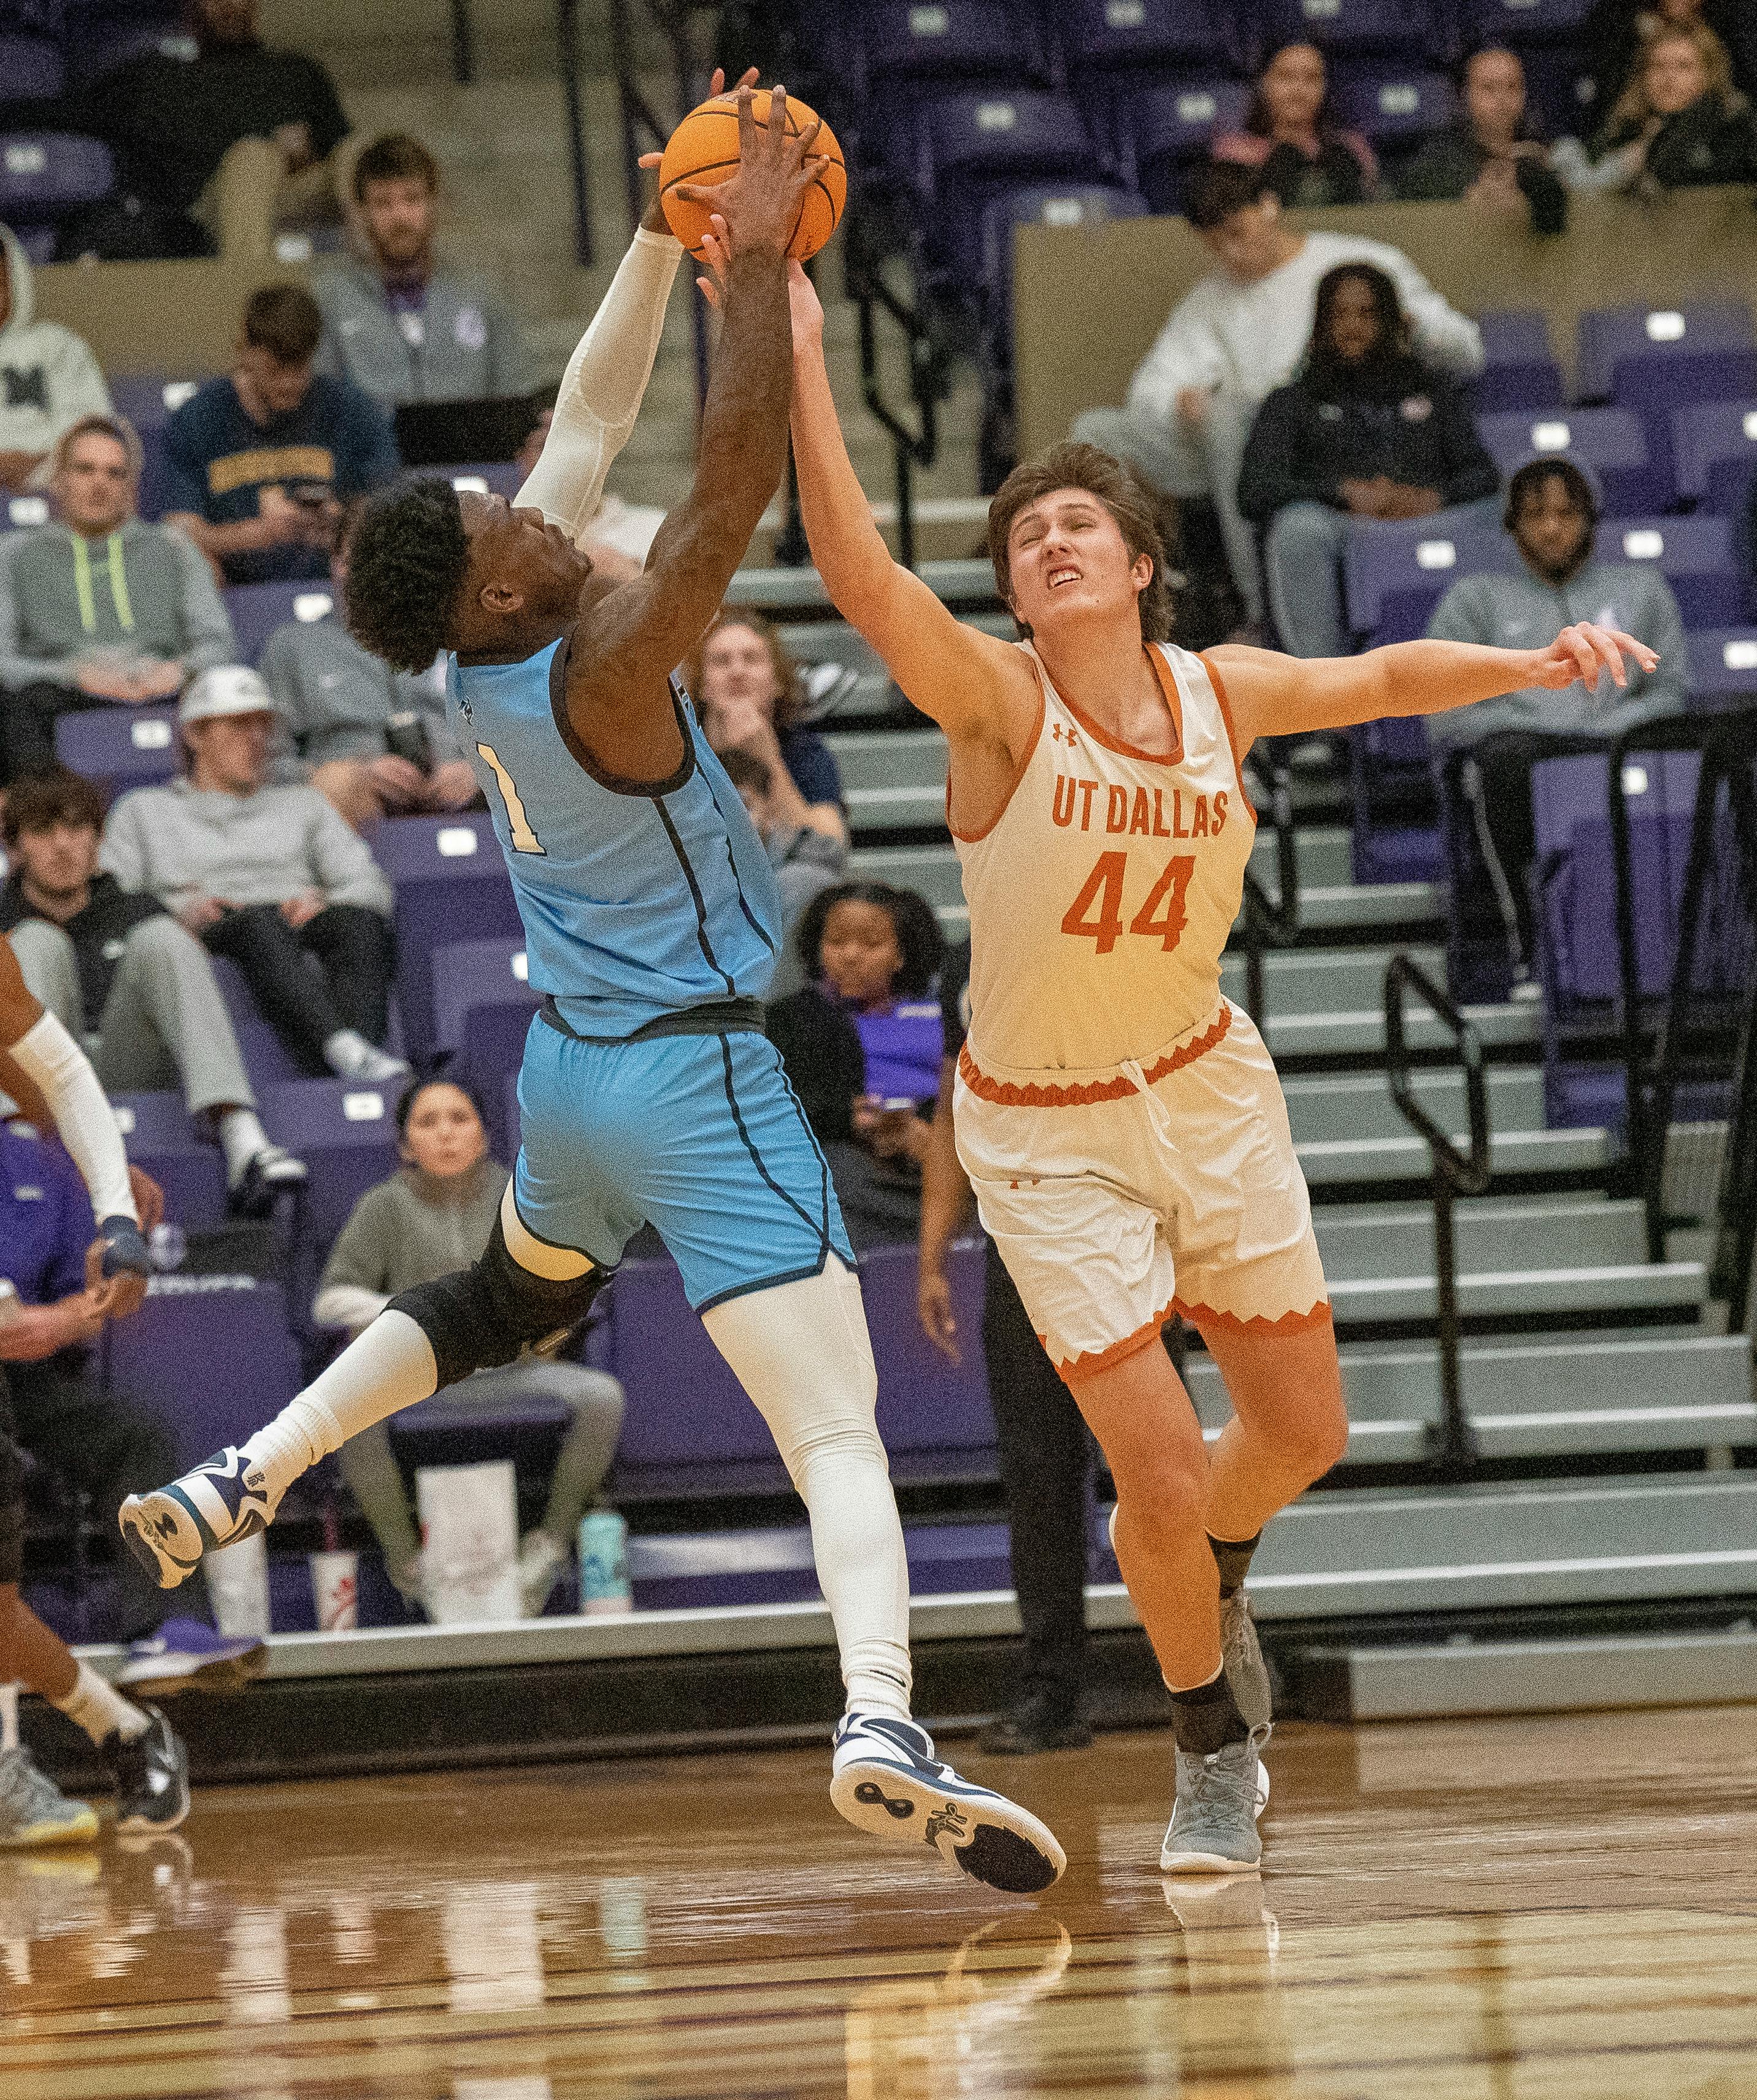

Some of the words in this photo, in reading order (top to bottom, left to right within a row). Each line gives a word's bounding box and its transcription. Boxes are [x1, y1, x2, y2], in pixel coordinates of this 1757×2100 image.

[476, 742, 547, 856] 1
[1052, 774, 1098, 831] UT
[1106, 785, 1228, 839] DALLAS
[1061, 851, 1196, 955] 44
